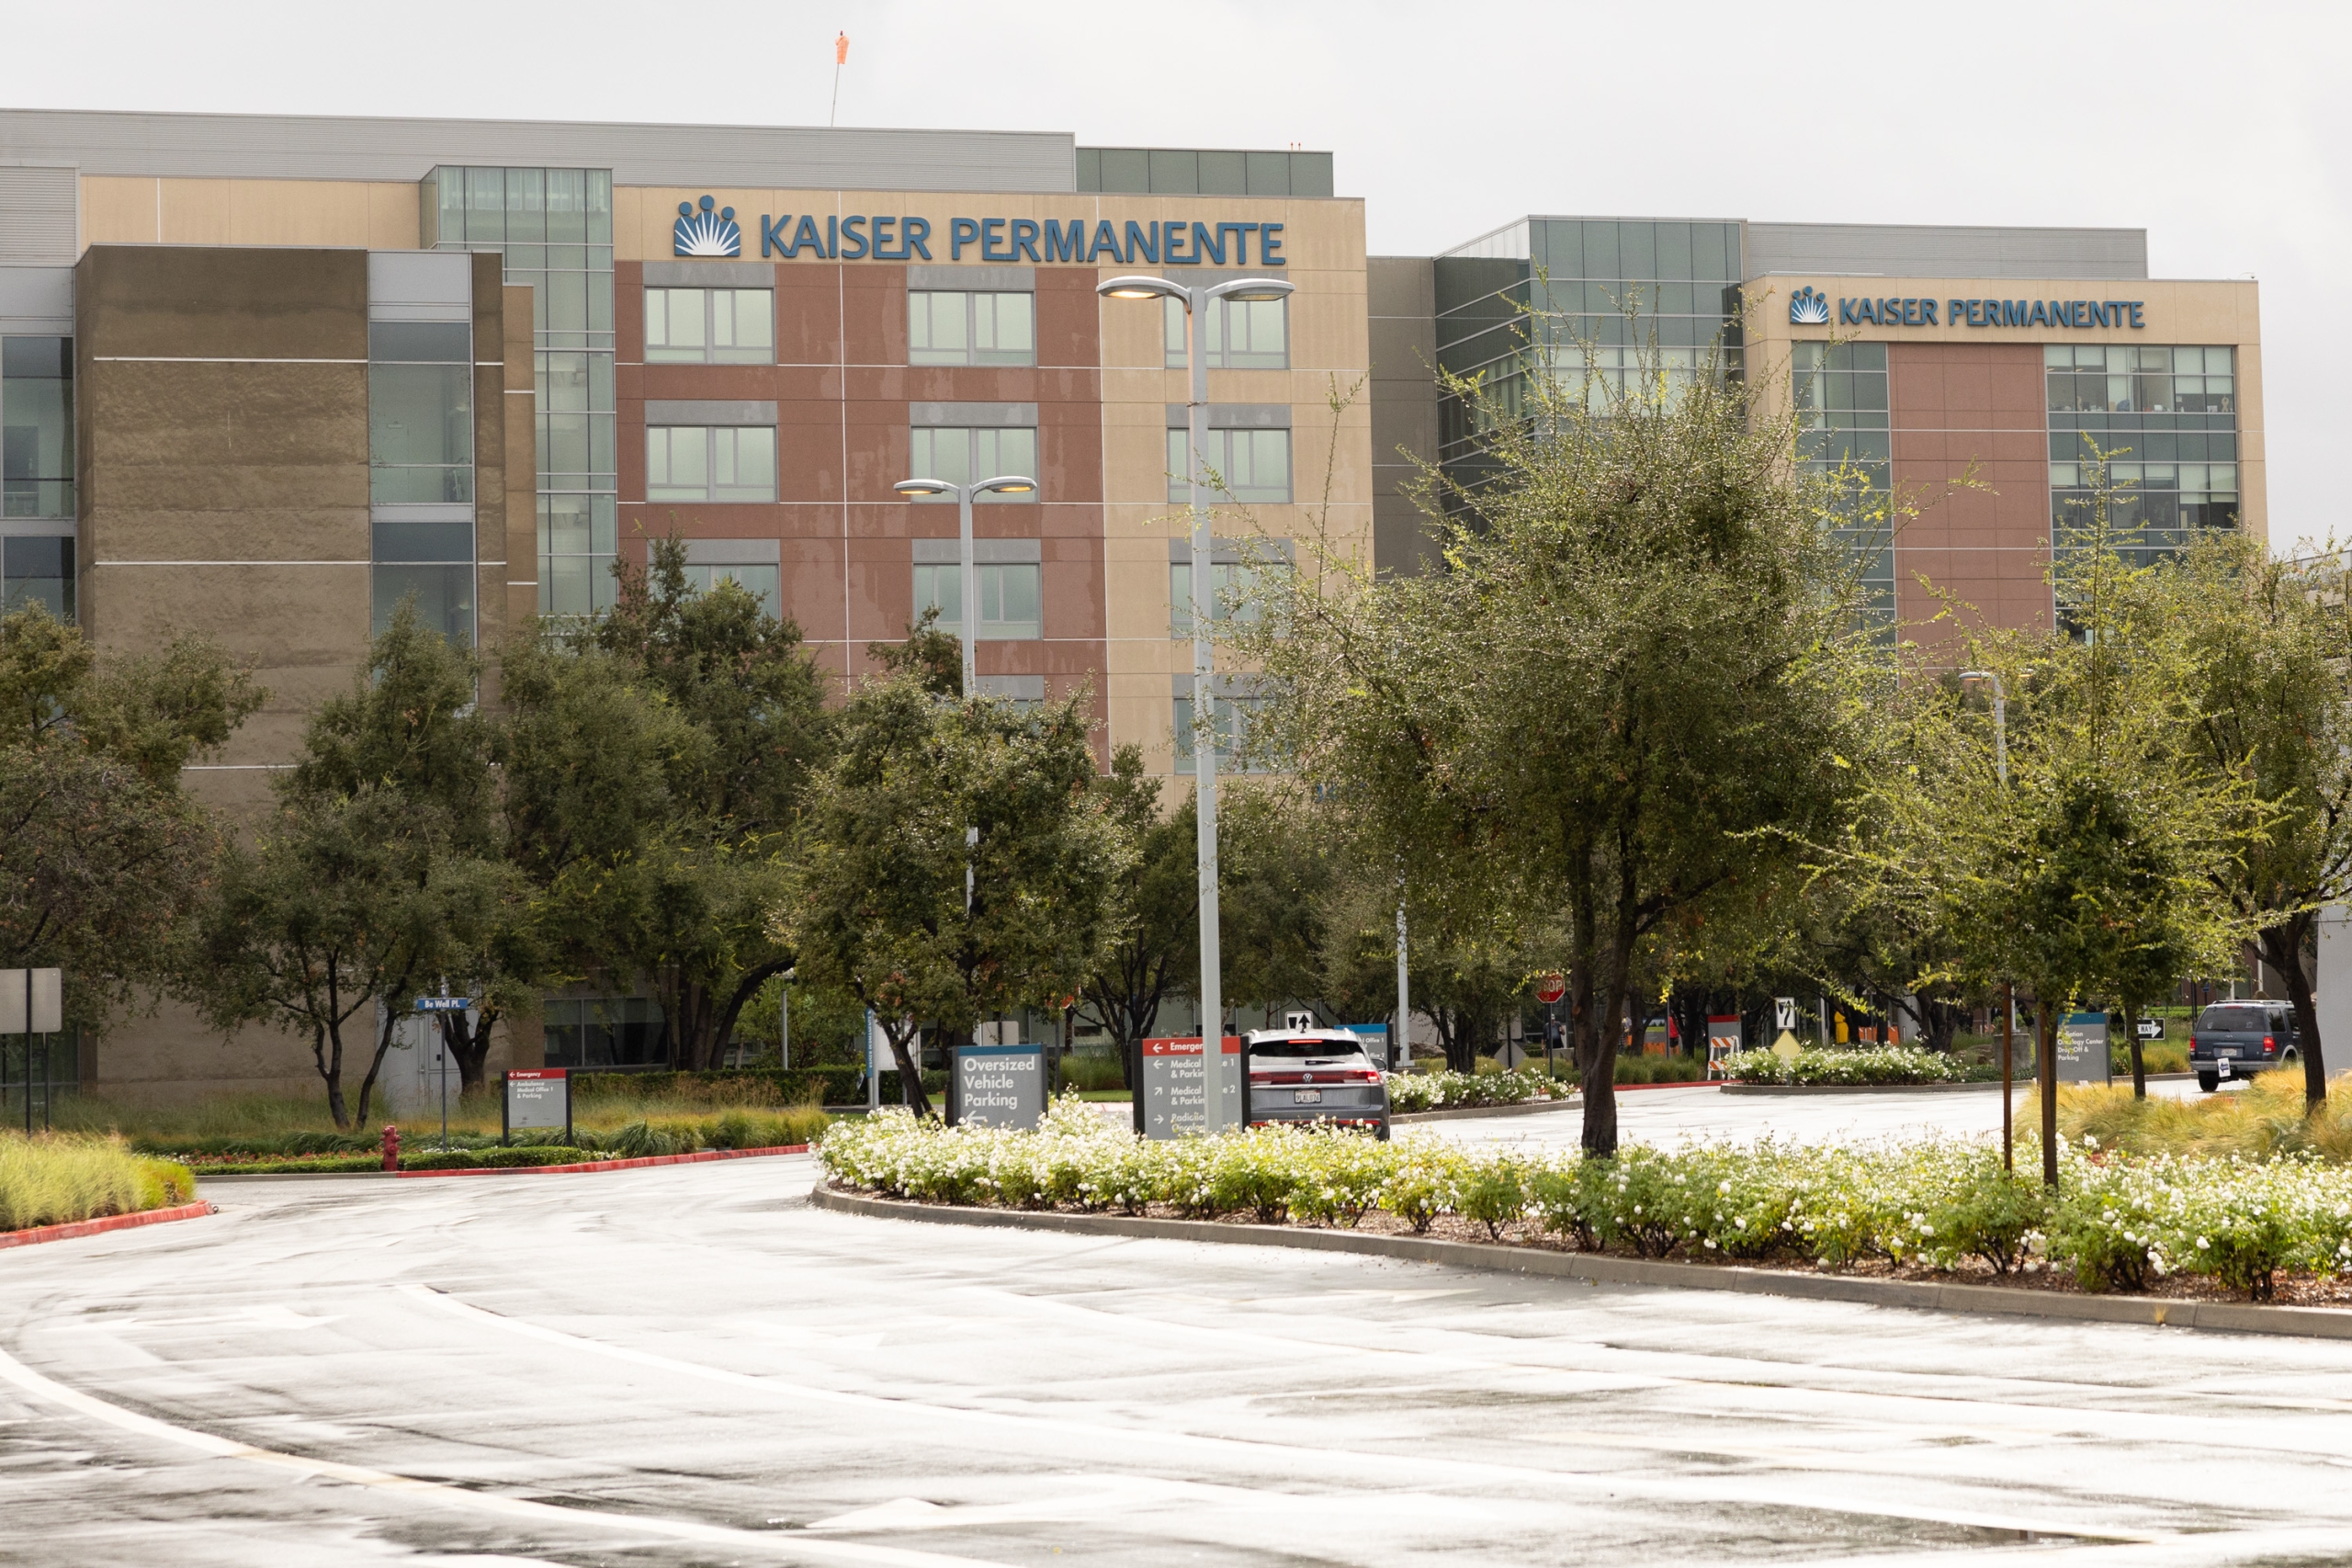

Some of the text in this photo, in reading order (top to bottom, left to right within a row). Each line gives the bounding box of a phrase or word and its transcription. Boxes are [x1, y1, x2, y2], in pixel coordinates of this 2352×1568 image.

[761, 214, 1286, 265] KAISER PERMANENTE
[1839, 298, 2146, 328] KAISER PERMANENTE
[424, 999, 434, 1008] Be
[435, 999, 449, 1008] Well
[2057, 1038, 2085, 1046] Ology
[1170, 1042, 1204, 1053] Emergen
[1170, 1058, 1202, 1068] Medical
[1230, 1058, 1235, 1066] 1
[2058, 1054, 2079, 1062] Parking
[964, 1055, 1035, 1072] Oversized
[1180, 1069, 1204, 1078] Parkin
[964, 1073, 1014, 1089] Vehicle
[1170, 1085, 1202, 1095] Medical
[1229, 1085, 1236, 1093] 2
[964, 1091, 1018, 1110] Parking
[1180, 1096, 1204, 1105] Parkin
[1171, 1111, 1204, 1122] Radiatio
